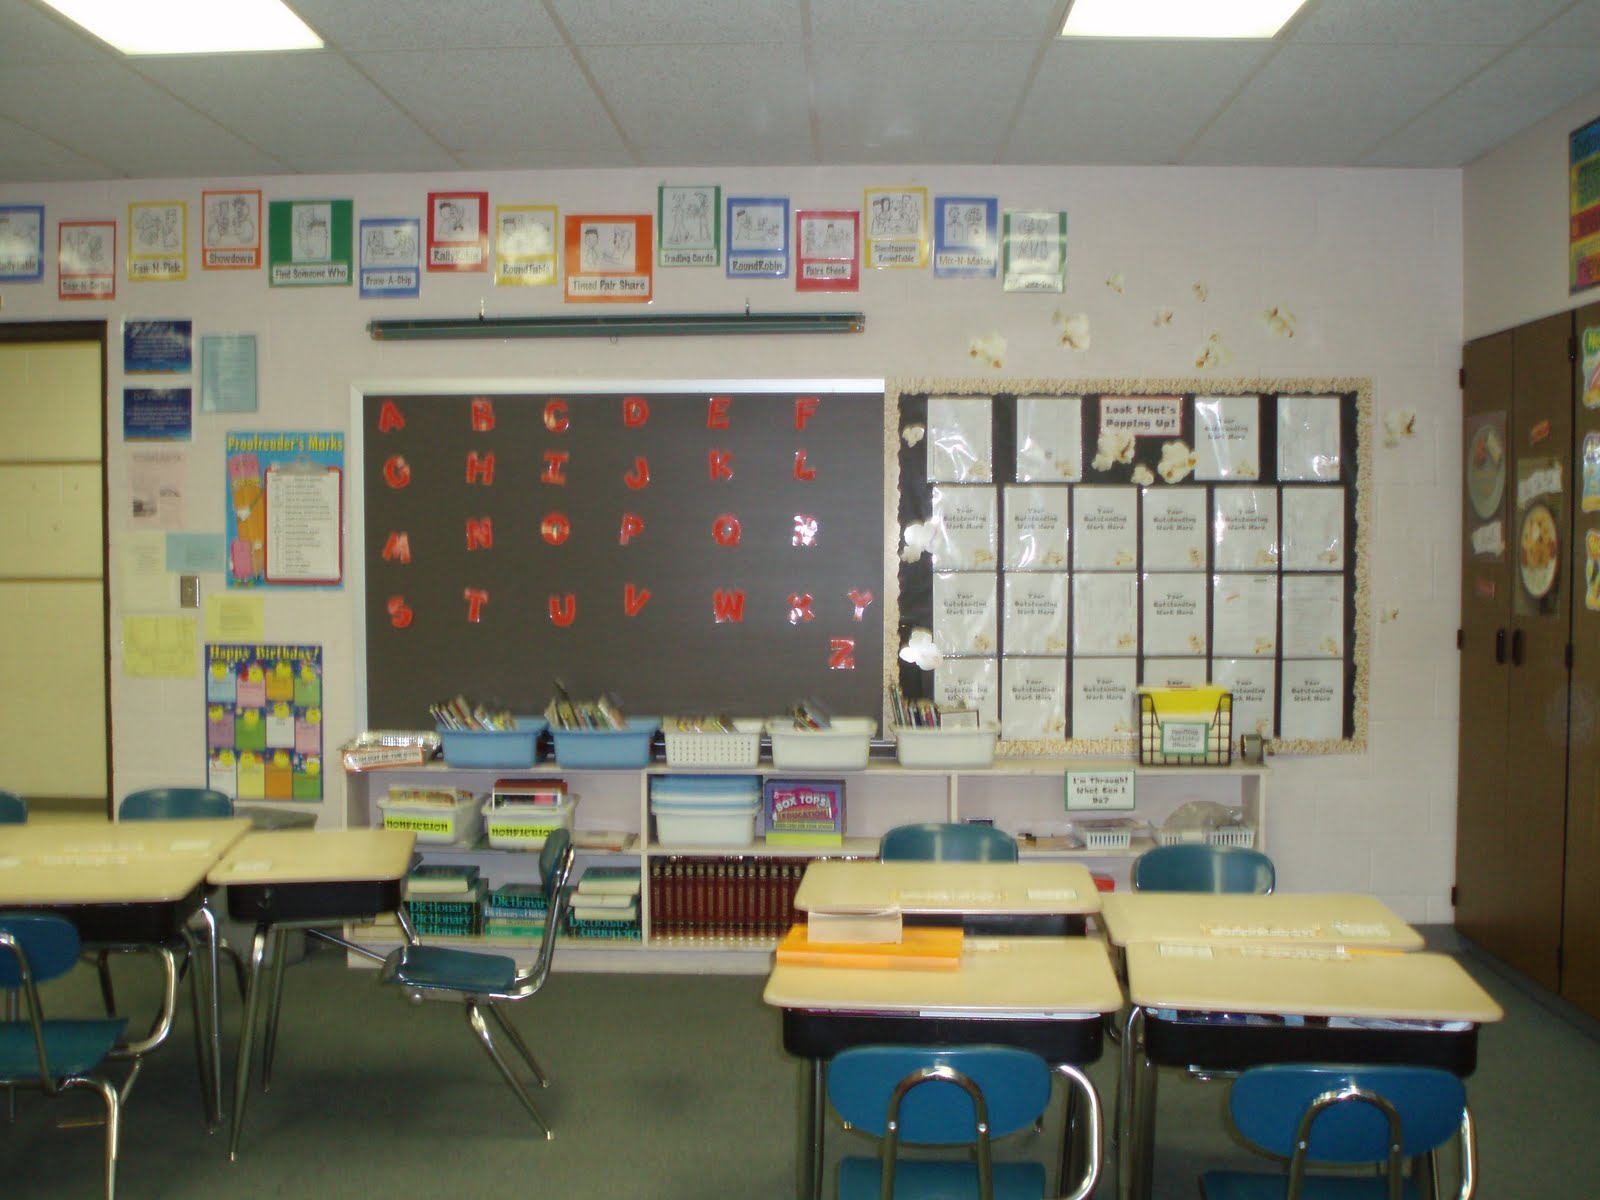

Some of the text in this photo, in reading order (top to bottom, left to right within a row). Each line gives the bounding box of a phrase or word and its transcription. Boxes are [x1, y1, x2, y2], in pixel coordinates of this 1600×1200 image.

[209, 253, 254, 264] Showdown
[664, 253, 713, 264] Trading Cards
[732, 260, 783, 271] RoundRobin
[806, 265, 847, 276] Pairs Check
[275, 268, 346, 280] Find Someone Who
[366, 275, 412, 286] Draw-A-Chip
[573, 280, 645, 291] Timed Pair Share
[378, 396, 819, 432] A B C D E F
[1106, 405, 1176, 414] Look What's
[1106, 419, 1176, 430] Popping Up!
[228, 434, 344, 452] Proofreader's Marks
[384, 449, 816, 490] G H I J K L
[465, 518, 493, 551] N
[541, 512, 571, 546] O
[619, 512, 644, 544] P
[712, 514, 741, 547] Q
[387, 583, 873, 629] S T U V W X Y
[210, 645, 250, 663] Happy
[829, 637, 855, 669] Z
[1090, 777, 1128, 785] Through!
[776, 796, 798, 812] BOX
[800, 795, 826, 808] TOPS
[410, 902, 470, 913] Dictionary
[492, 895, 549, 908] Dictionar
[410, 913, 471, 925] Dictionary
